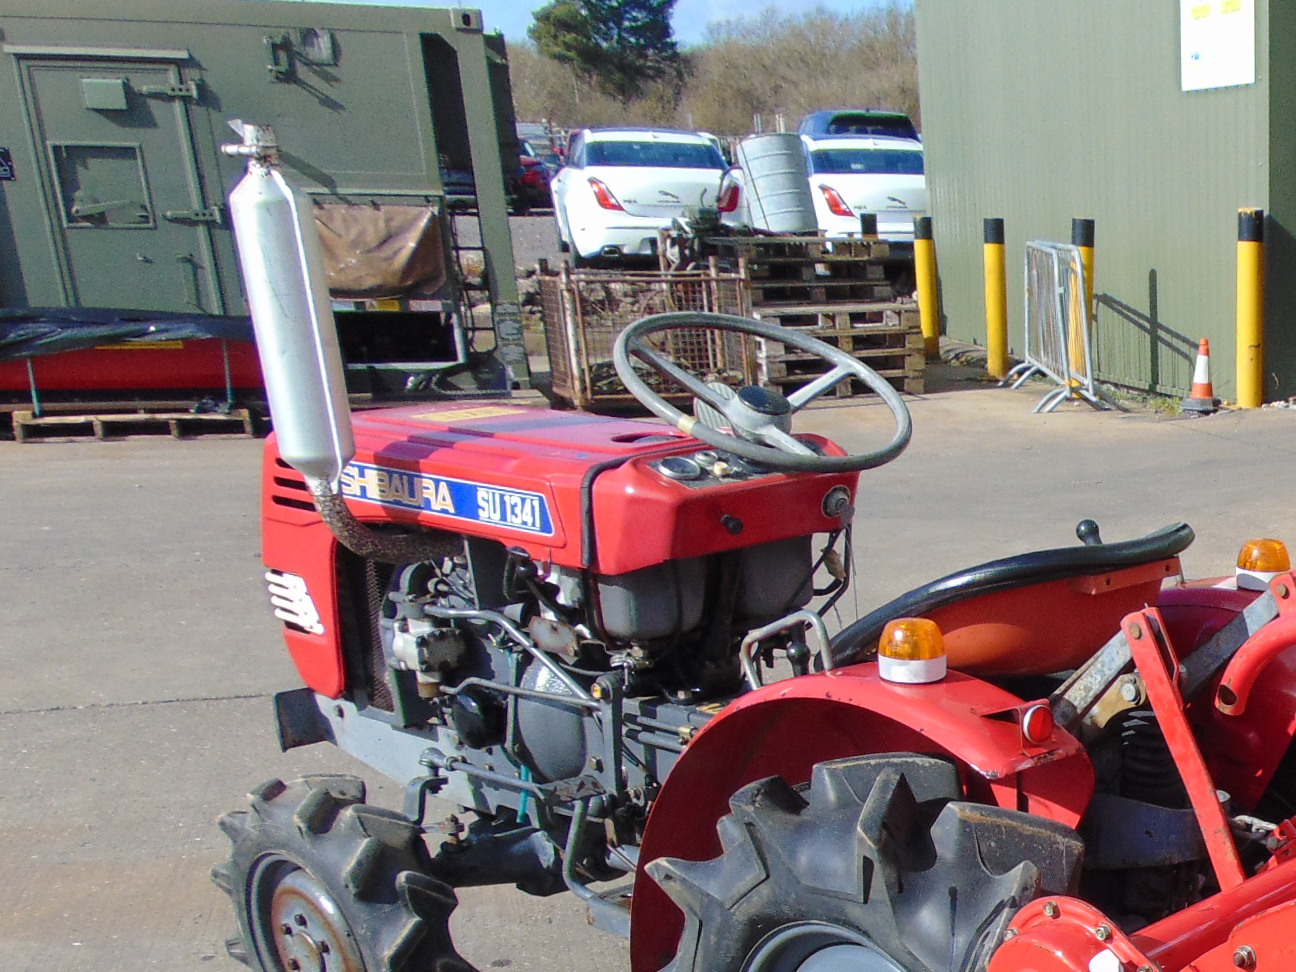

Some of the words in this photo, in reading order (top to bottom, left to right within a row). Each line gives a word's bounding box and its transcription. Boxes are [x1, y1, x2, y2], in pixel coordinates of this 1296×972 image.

[341, 465, 455, 513] SHIBAURA
[477, 489, 500, 521] SU
[503, 494, 541, 528] 1341
